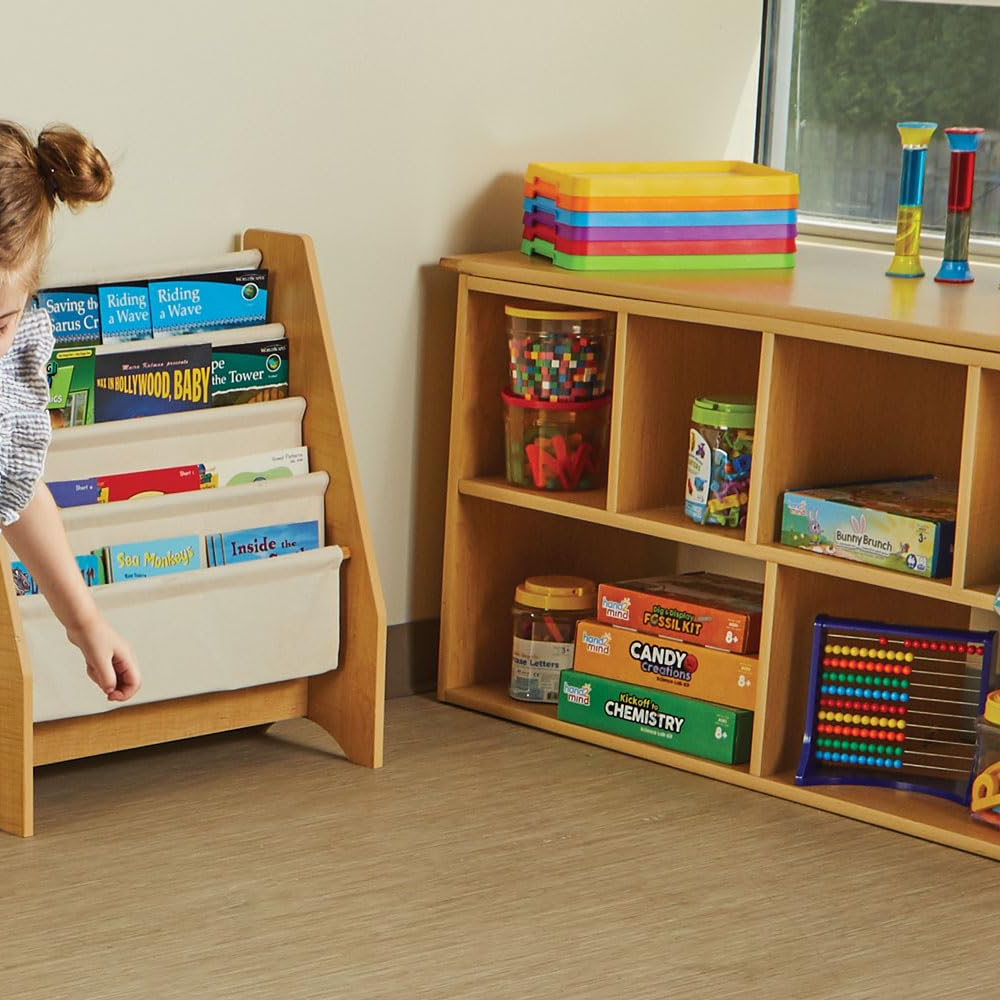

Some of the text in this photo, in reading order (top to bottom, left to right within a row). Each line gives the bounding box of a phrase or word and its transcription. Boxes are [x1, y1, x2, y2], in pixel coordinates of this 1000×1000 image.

[107, 292, 147, 309] Riding
[158, 287, 200, 304] Riding
[46, 298, 86, 315] Saving
[87, 297, 98, 310] th
[159, 303, 202, 320] a Wave
[108, 308, 149, 324] a Wave
[115, 370, 172, 402] HOLLYWOOD,
[174, 366, 211, 403] BABY
[212, 370, 265, 386] the Tower
[231, 536, 276, 556] Inside
[281, 540, 297, 549] the
[836, 530, 863, 546] Bunny
[863, 533, 893, 552] Brunch
[117, 546, 195, 569] Sea Monkeys
[606, 608, 629, 620] mind
[669, 608, 694, 621] Display
[644, 612, 702, 635] FOSSIL KIT
[725, 630, 739, 644] 8+
[587, 643, 610, 654] mind
[630, 642, 687, 669] CANDY
[530, 659, 559, 668] Letters
[642, 662, 691, 681] Creations
[737, 674, 751, 688] 8+
[567, 694, 589, 705] mind
[619, 693, 650, 709] Kickoff
[605, 700, 685, 733] CHEMISTRY
[714, 726, 728, 740] 8+
